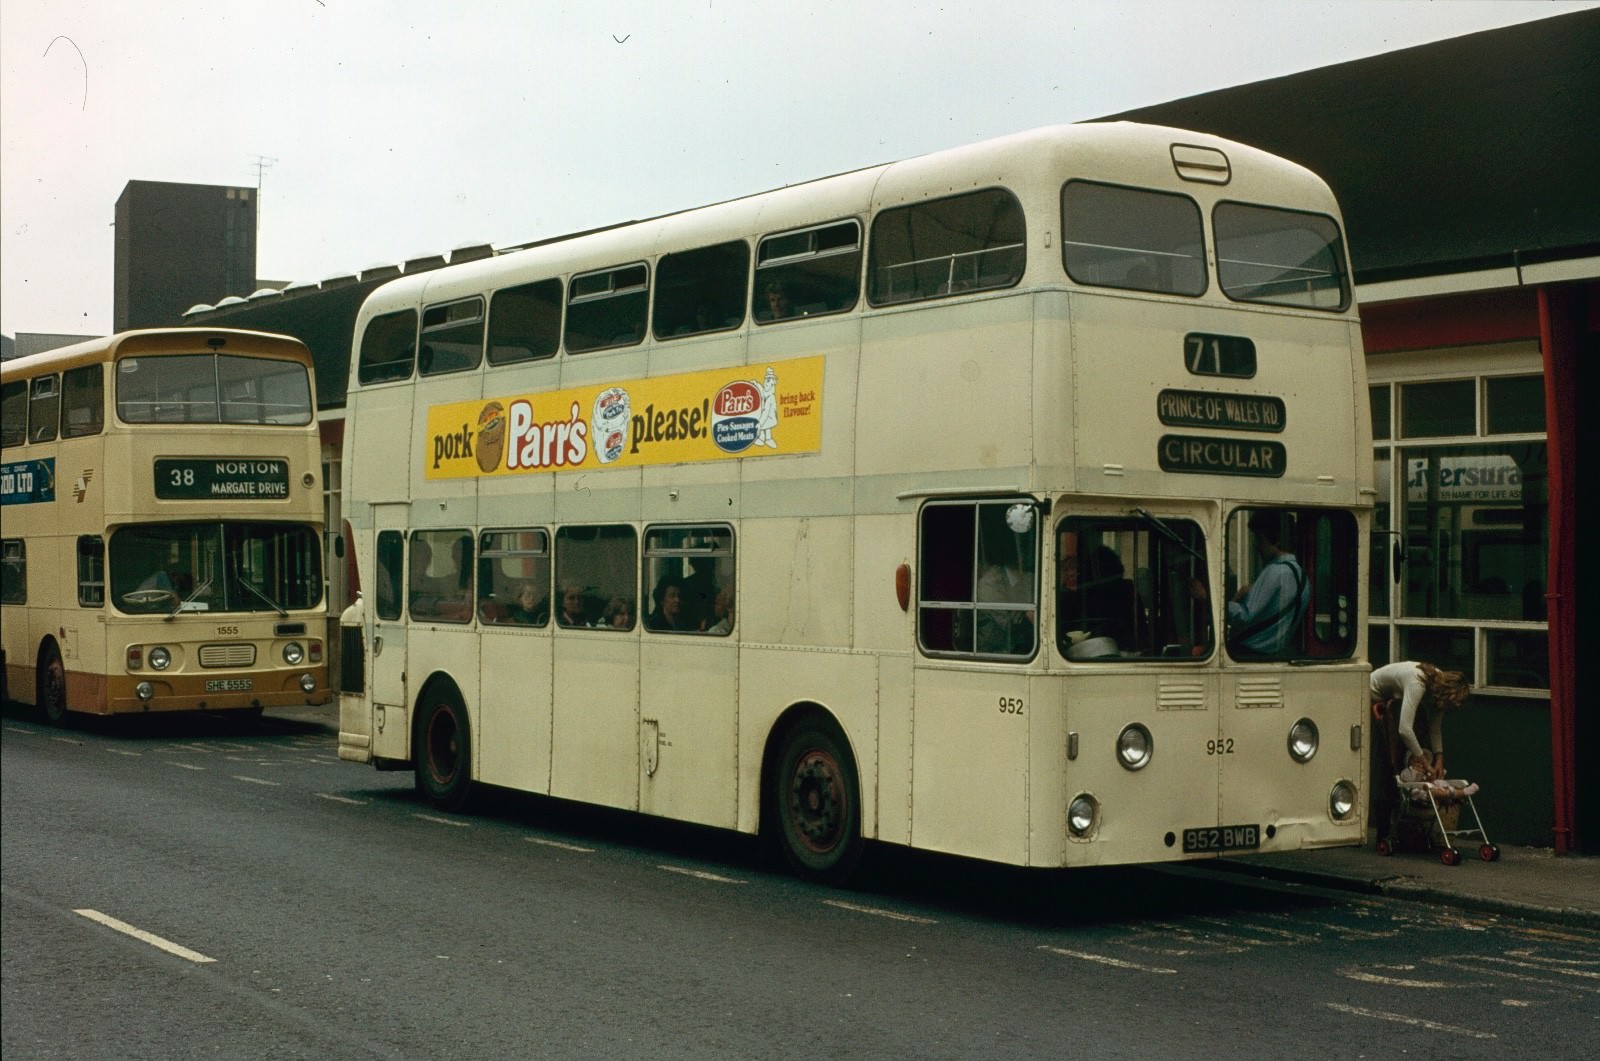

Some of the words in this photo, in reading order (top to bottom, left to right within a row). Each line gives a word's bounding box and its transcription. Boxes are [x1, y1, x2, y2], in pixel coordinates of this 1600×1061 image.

[1187, 337, 1221, 374] 71
[721, 388, 754, 414] Parr's
[780, 392, 798, 406] bring
[799, 390, 815, 402] back
[1160, 394, 1204, 419] PRINCE
[1206, 398, 1222, 421] OF
[1225, 399, 1260, 424] WALES
[507, 400, 587, 469] Parr's
[630, 398, 709, 454] please!
[433, 423, 474, 469] pork
[717, 432, 738, 443] Cooked
[738, 431, 754, 441] Meats
[1165, 440, 1273, 469] CIRCULAR
[170, 468, 195, 486] 38
[215, 462, 280, 475] NORTON
[17, 472, 33, 493] LTD
[211, 481, 256, 494] MARGATE
[258, 482, 287, 494] DRIVE
[1474, 490, 1490, 499] FOR
[1491, 490, 1506, 498] LIFE
[217, 626, 239, 635] 1555
[207, 680, 225, 690] SHE
[227, 679, 252, 690] 555S
[999, 696, 1024, 715] 952
[1207, 738, 1234, 755] 952
[1186, 830, 1219, 849] 952
[1223, 828, 1256, 847] BWB
